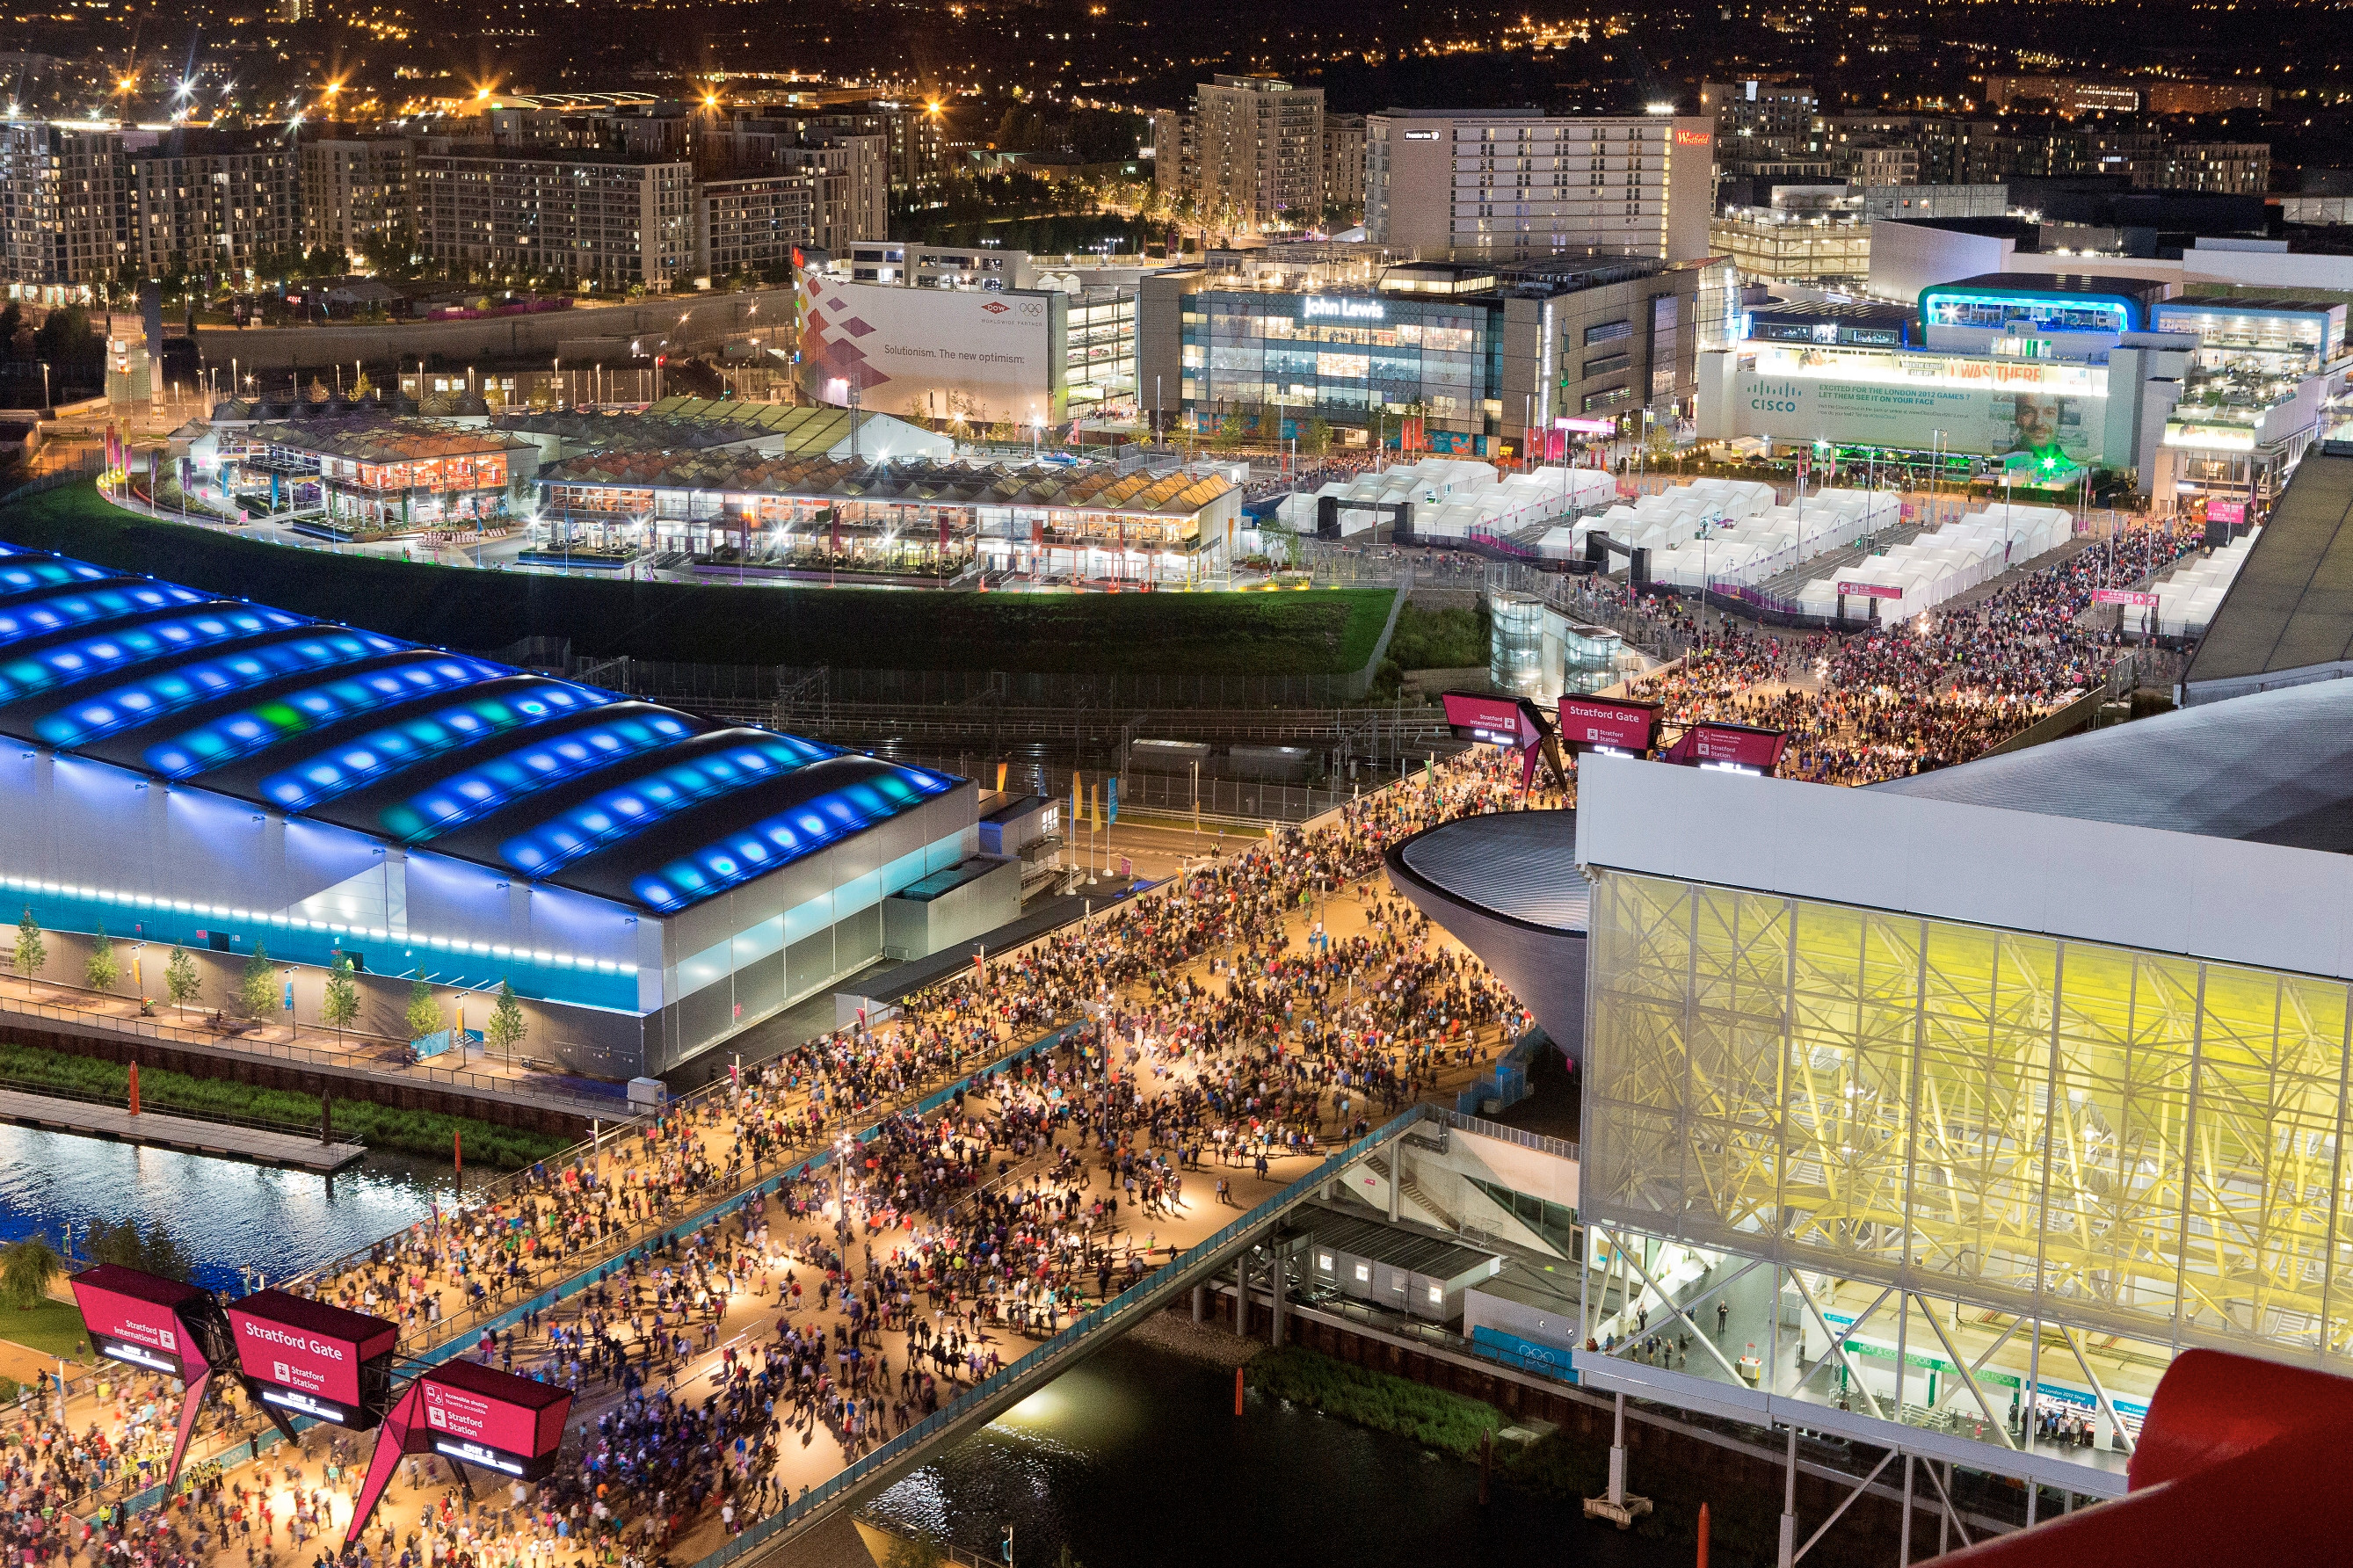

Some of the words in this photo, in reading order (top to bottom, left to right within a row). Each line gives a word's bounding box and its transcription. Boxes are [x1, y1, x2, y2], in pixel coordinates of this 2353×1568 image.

[1677, 131, 1710, 145] Westfield
[1303, 296, 1340, 317] John
[1342, 298, 1383, 318] Lewis
[884, 345, 936, 358] Solutionism.
[939, 349, 956, 359] The
[958, 352, 977, 360] new
[1961, 364, 1991, 379] WAS
[1995, 366, 2041, 383] THERE
[1752, 398, 1796, 412] CISCO
[1570, 706, 1613, 719] Stratford
[1616, 712, 1639, 722] Gate
[1470, 719, 1503, 728] International
[126, 1319, 158, 1335] Stratford
[114, 1326, 159, 1346] International
[245, 1322, 306, 1350] Stratford
[309, 1340, 343, 1361] Gate
[1858, 1344, 1874, 1353] HOT
[1908, 1355, 1931, 1366] FOOD
[291, 1367, 324, 1383] Stratford
[1941, 1361, 1957, 1371] HOT
[1991, 1373, 2015, 1384] FOOD
[292, 1377, 319, 1391] Station
[447, 1412, 483, 1428] Stratford
[448, 1422, 477, 1438] Station
